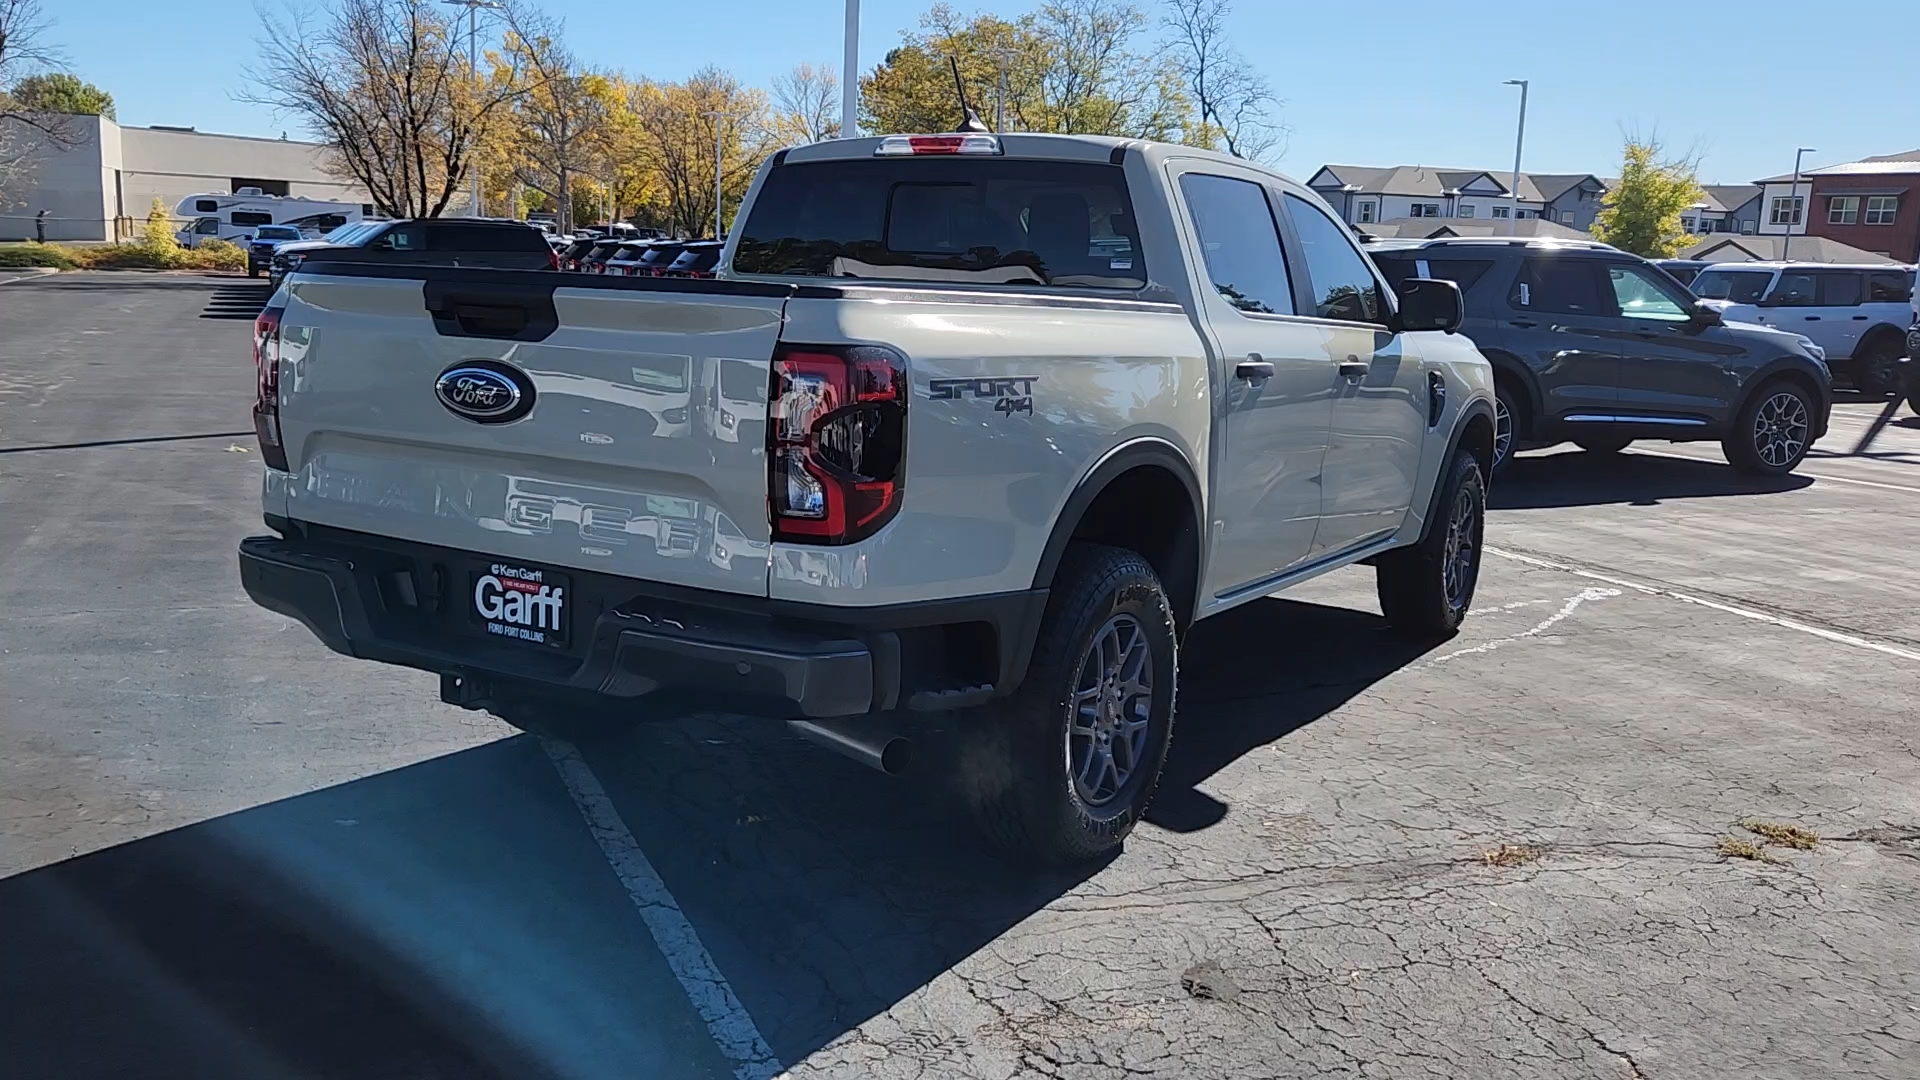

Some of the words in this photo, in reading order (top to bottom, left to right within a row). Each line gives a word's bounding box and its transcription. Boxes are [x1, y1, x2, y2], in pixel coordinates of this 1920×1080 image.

[453, 377, 508, 405] Ford
[929, 376, 1039, 400] SPORT
[994, 397, 1034, 418] 4x4
[500, 564, 519, 578] Ken
[519, 568, 543, 582] Garff
[475, 575, 563, 631] Garff
[488, 622, 503, 634] FORD
[504, 626, 519, 637] FORT
[520, 629, 544, 643] COLLINS
